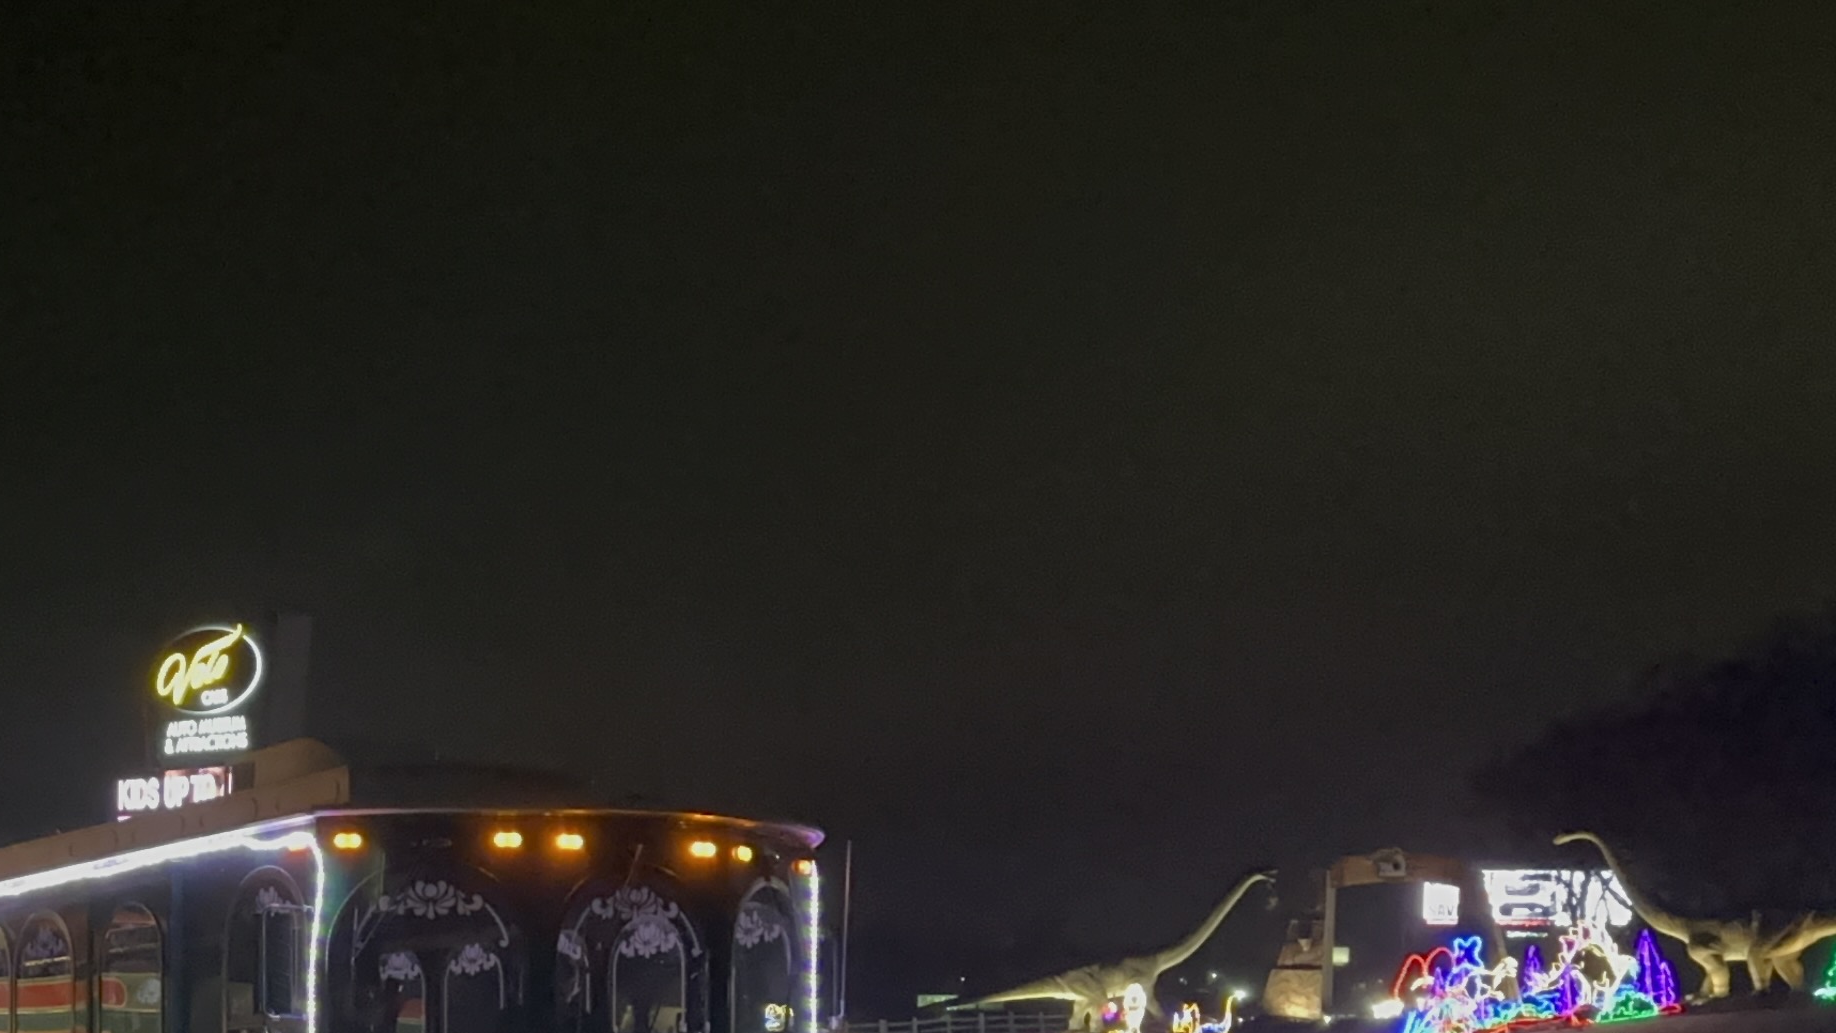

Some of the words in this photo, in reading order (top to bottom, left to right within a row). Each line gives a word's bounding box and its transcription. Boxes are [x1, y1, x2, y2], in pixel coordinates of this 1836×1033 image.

[166, 720, 197, 738] AUTO
[117, 776, 160, 812] KIDS
[163, 775, 190, 809] UP
[190, 773, 217, 804] TO
